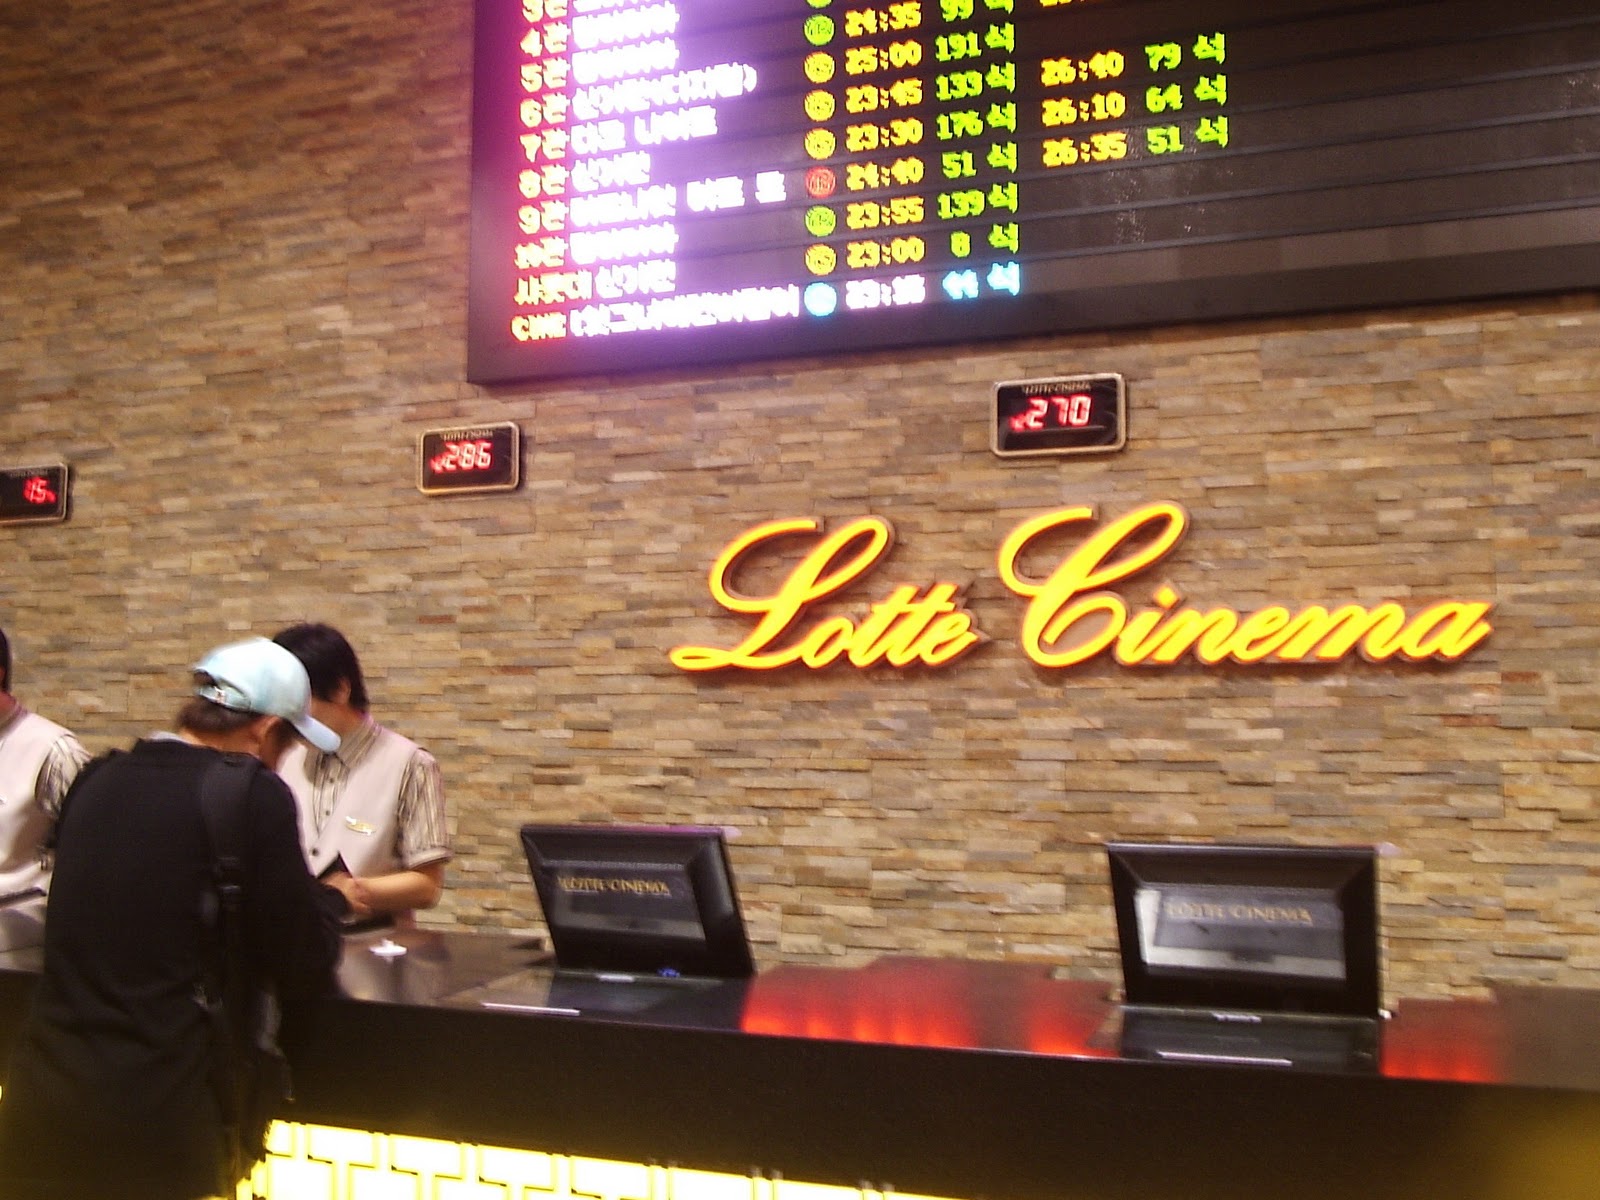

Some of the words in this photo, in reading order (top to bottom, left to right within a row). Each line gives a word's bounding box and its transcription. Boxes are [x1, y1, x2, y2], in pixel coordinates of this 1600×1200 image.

[520, 21, 571, 57] 4관
[520, 56, 570, 93] 5관
[519, 128, 570, 163] 7관
[1193, 33, 1225, 64] 석
[520, 92, 570, 128] 6관
[1042, 91, 1125, 127] 26:10
[1146, 84, 1182, 113] 64
[1194, 74, 1226, 105] 석
[518, 200, 569, 235] 9관
[942, 151, 976, 179] 51
[1147, 126, 1184, 155] 51
[1195, 116, 1228, 148] 석
[1026, 395, 1093, 431] 270
[671, 517, 978, 671] Lotte
[999, 502, 1492, 668] Cinema
